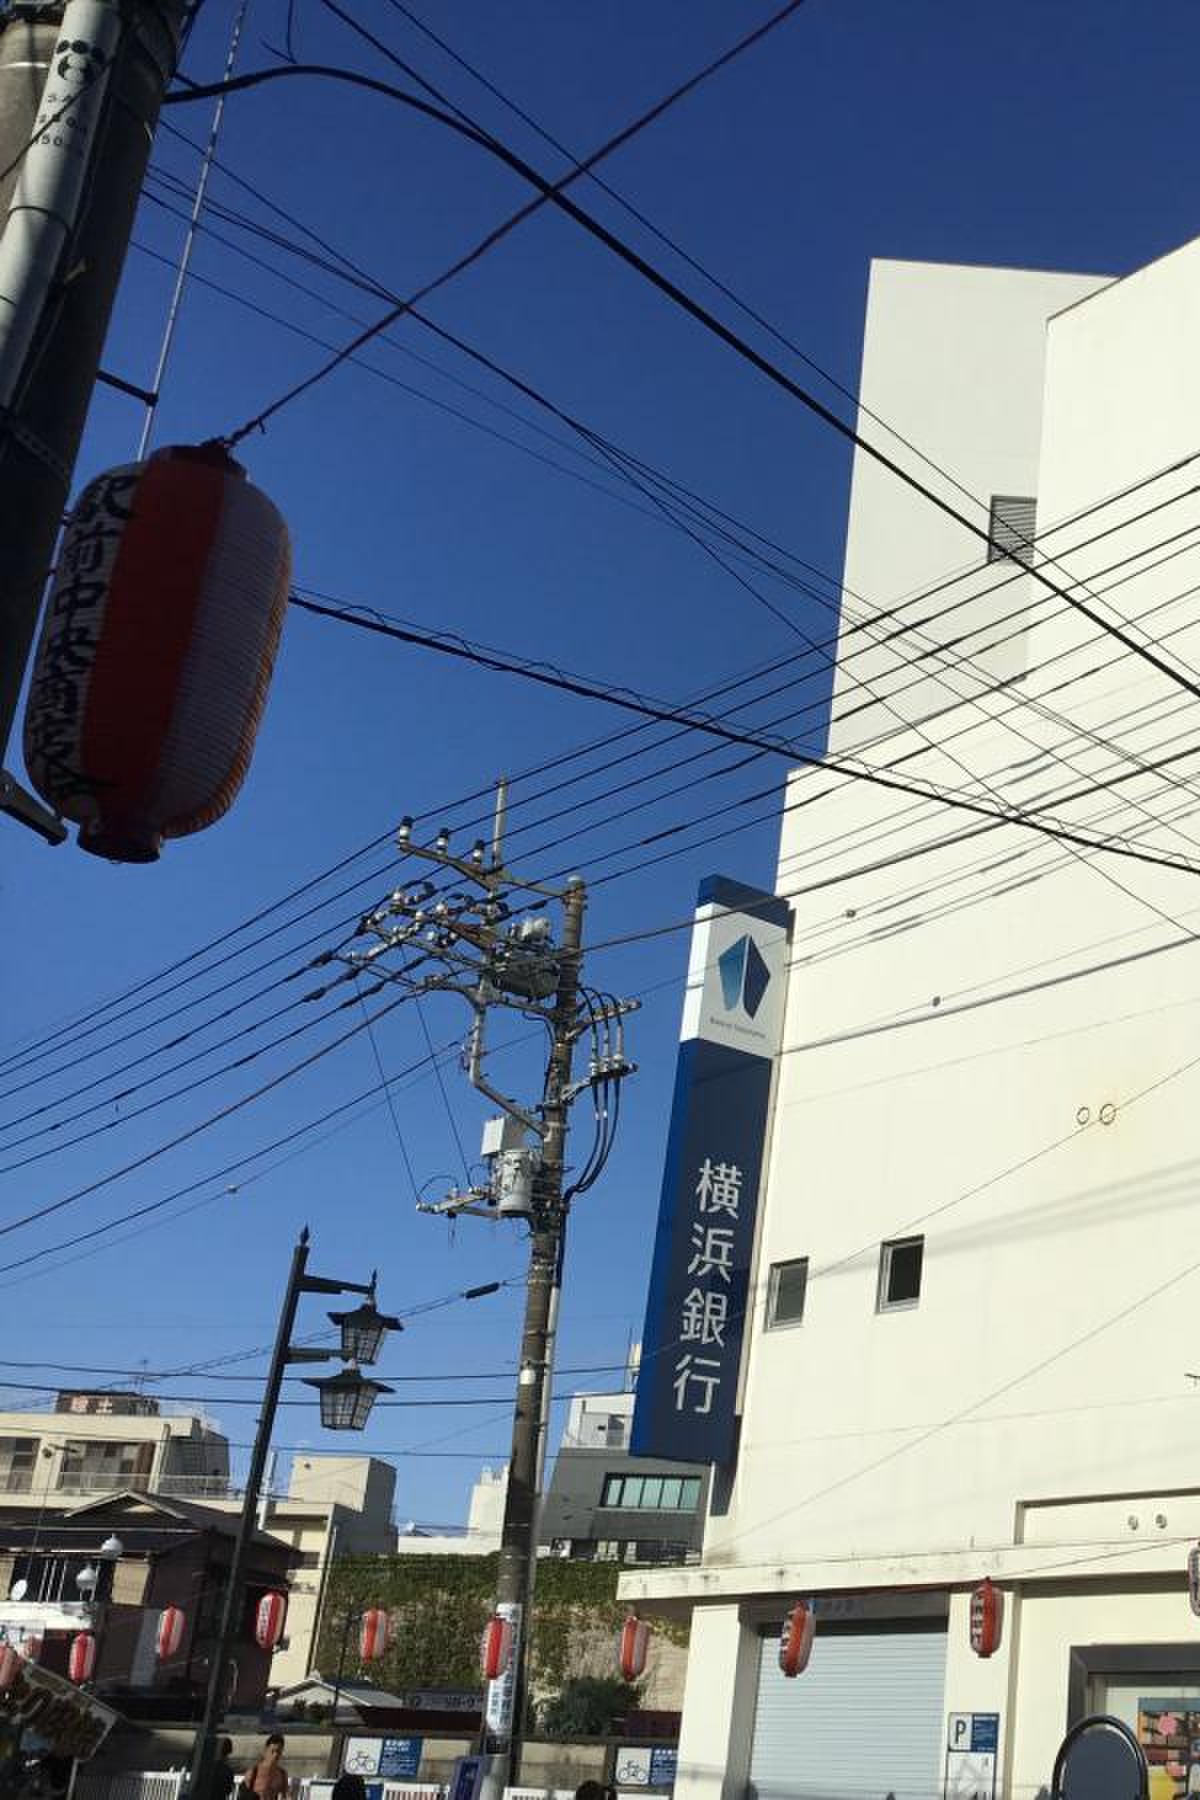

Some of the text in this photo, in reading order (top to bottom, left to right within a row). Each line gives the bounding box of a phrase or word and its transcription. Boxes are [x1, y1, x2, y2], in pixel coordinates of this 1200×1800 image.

[673, 1158, 743, 1414] 横浜銀行
[955, 1720, 967, 1744] P
